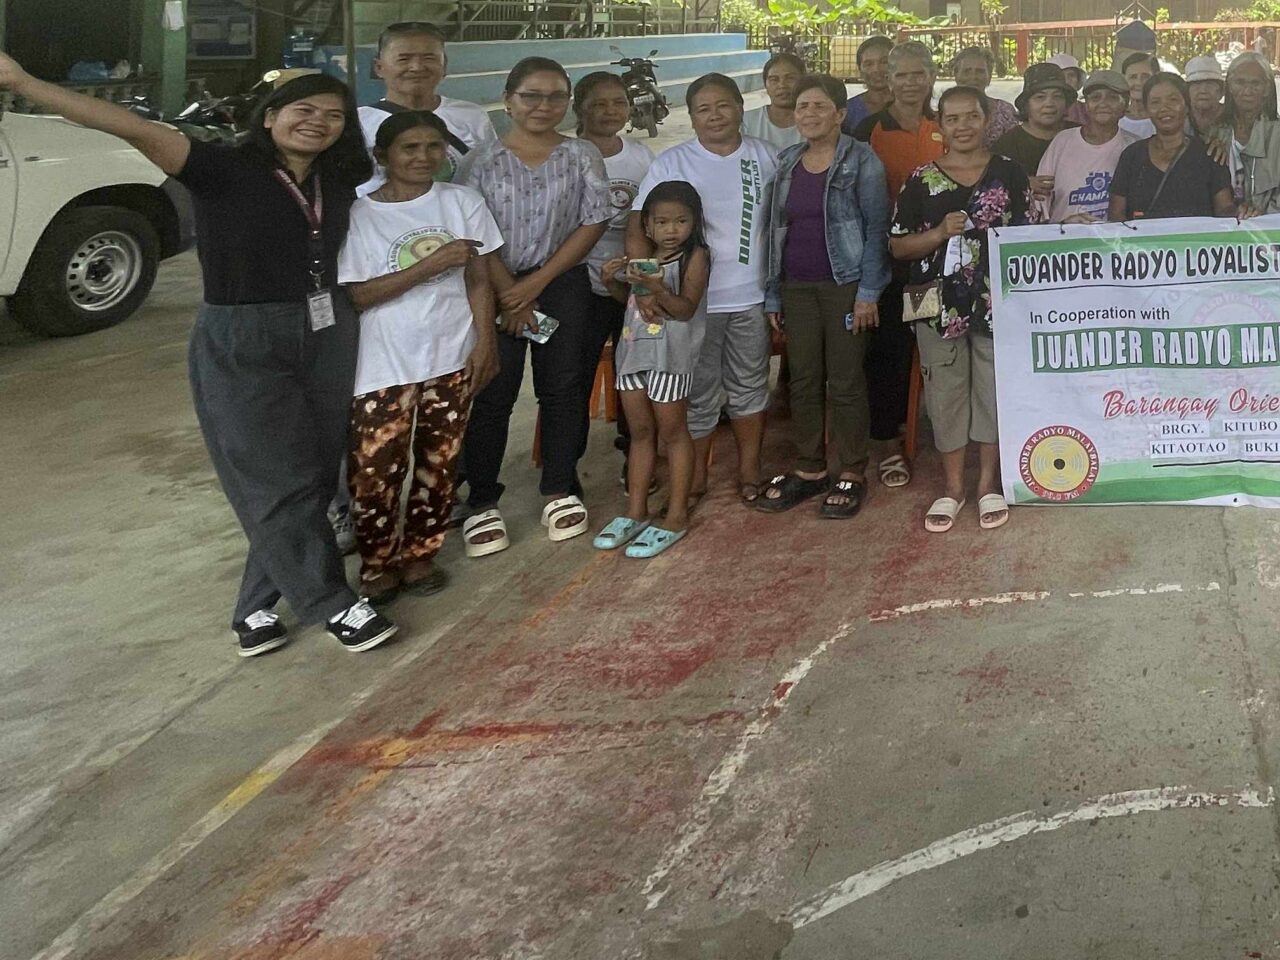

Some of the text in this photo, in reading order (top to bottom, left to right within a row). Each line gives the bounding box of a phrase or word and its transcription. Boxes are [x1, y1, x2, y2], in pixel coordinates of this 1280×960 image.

[738, 158, 754, 265] DUMPER
[1008, 251, 1104, 285] JUANDER
[1111, 249, 1177, 281] RADYO
[1030, 306, 1170, 324] In Cooperation with
[1036, 330, 1143, 369] JUANDER
[1151, 327, 1232, 366] RADYO
[1102, 389, 1219, 420] Barangay
[1161, 421, 1278, 435] BRGY. KITUBO
[1021, 427, 1098, 487] JUANDER RADYO MALAYBALAY
[1151, 441, 1226, 455] KITAOTAO
